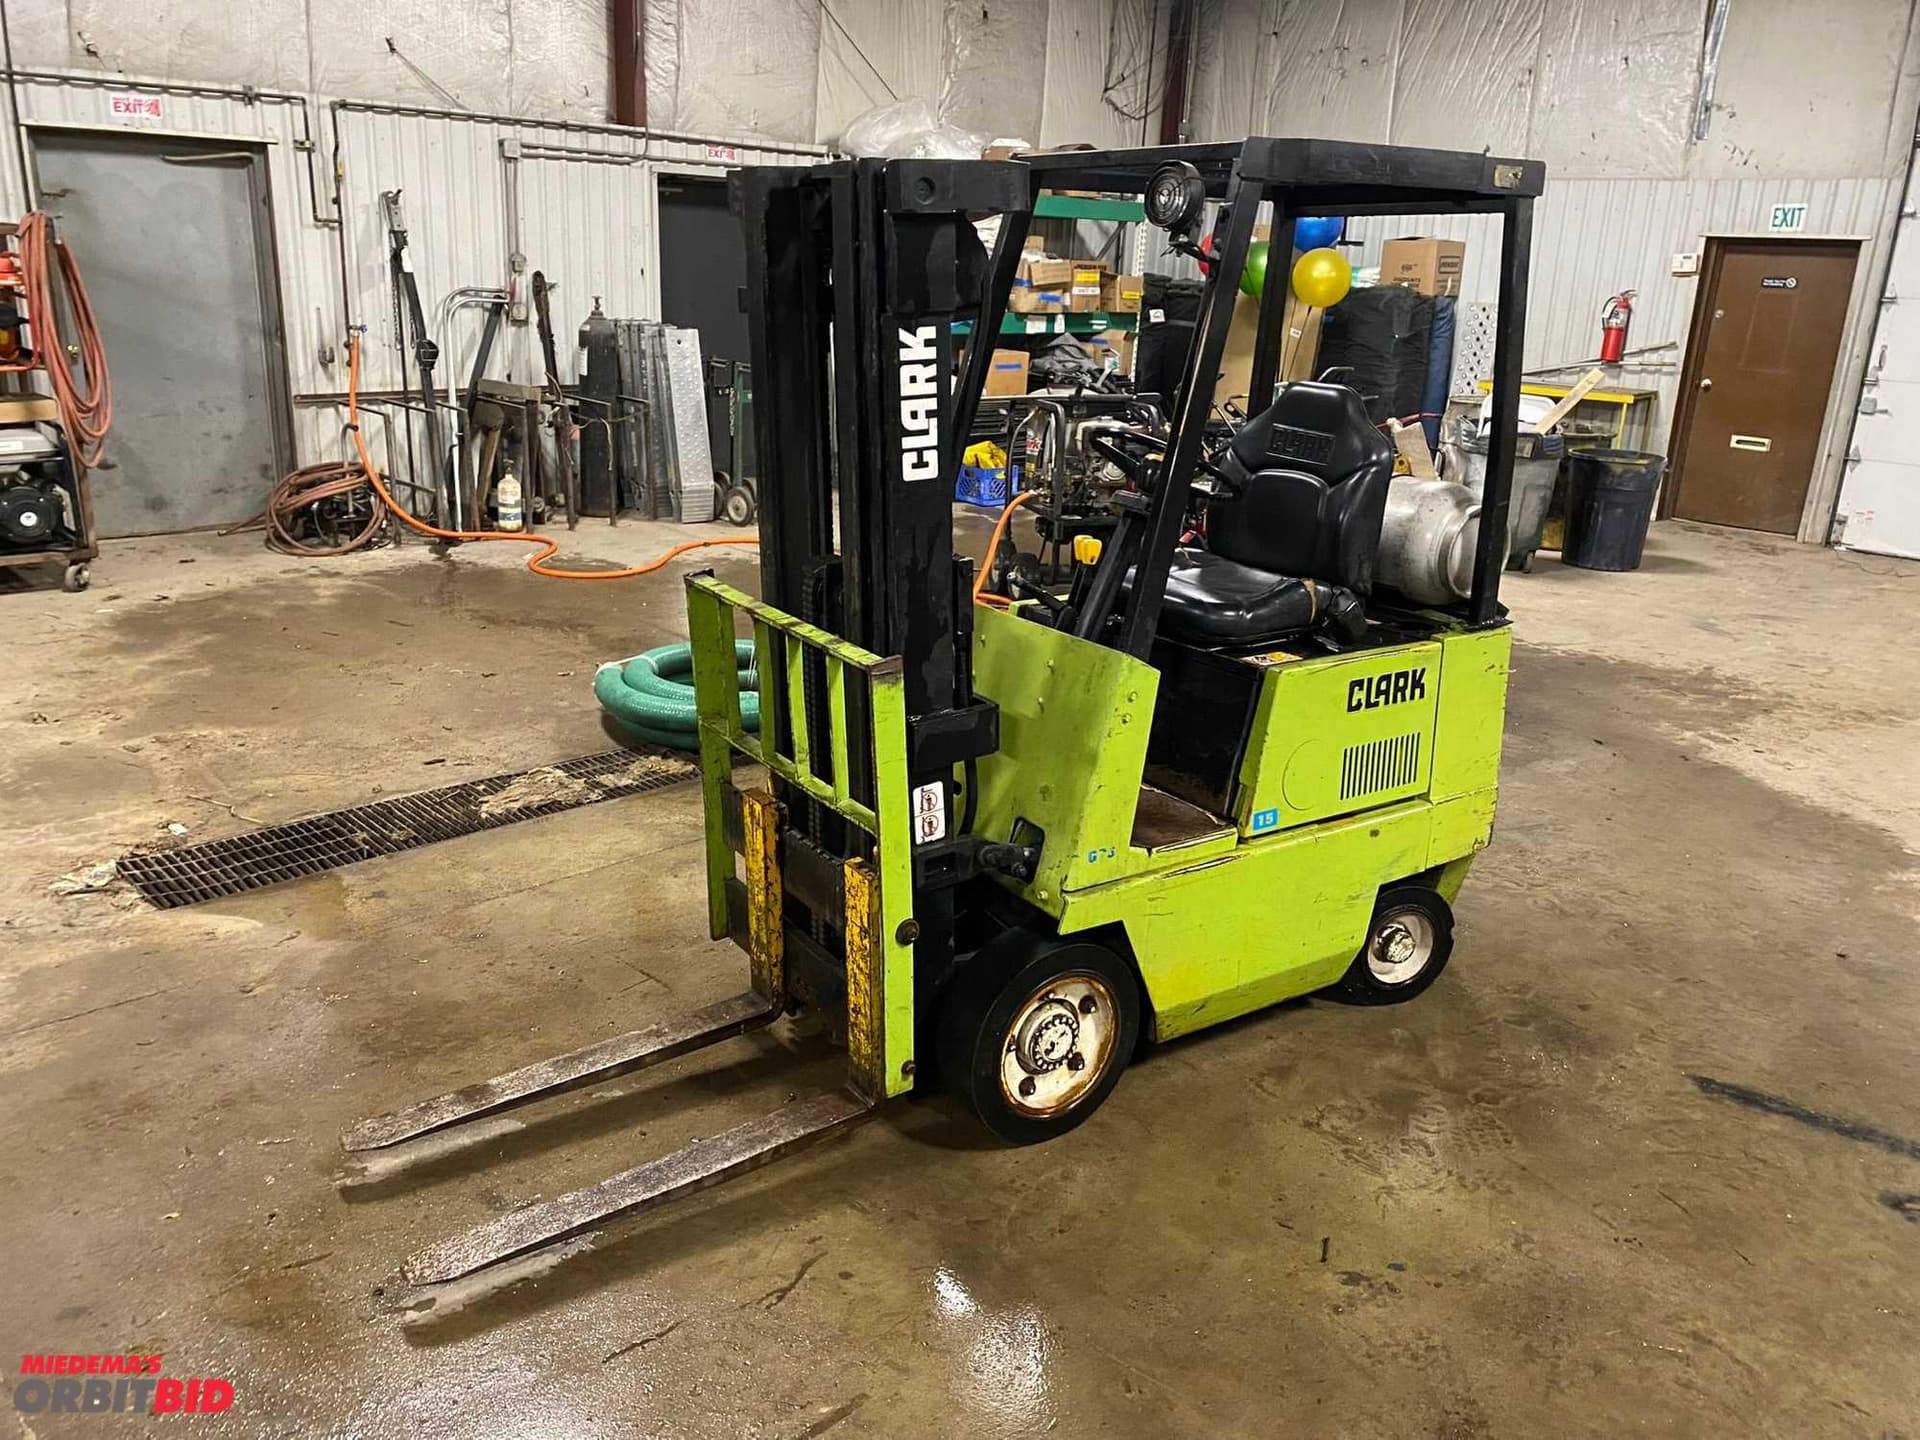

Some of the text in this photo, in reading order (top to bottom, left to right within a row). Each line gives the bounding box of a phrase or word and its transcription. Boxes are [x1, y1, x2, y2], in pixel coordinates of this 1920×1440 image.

[113, 101, 142, 113] EXIT
[1772, 207, 1805, 227] EXIT
[899, 326, 938, 482] CLARK
[1347, 667, 1426, 712] CLARK
[1258, 812, 1274, 827] 15
